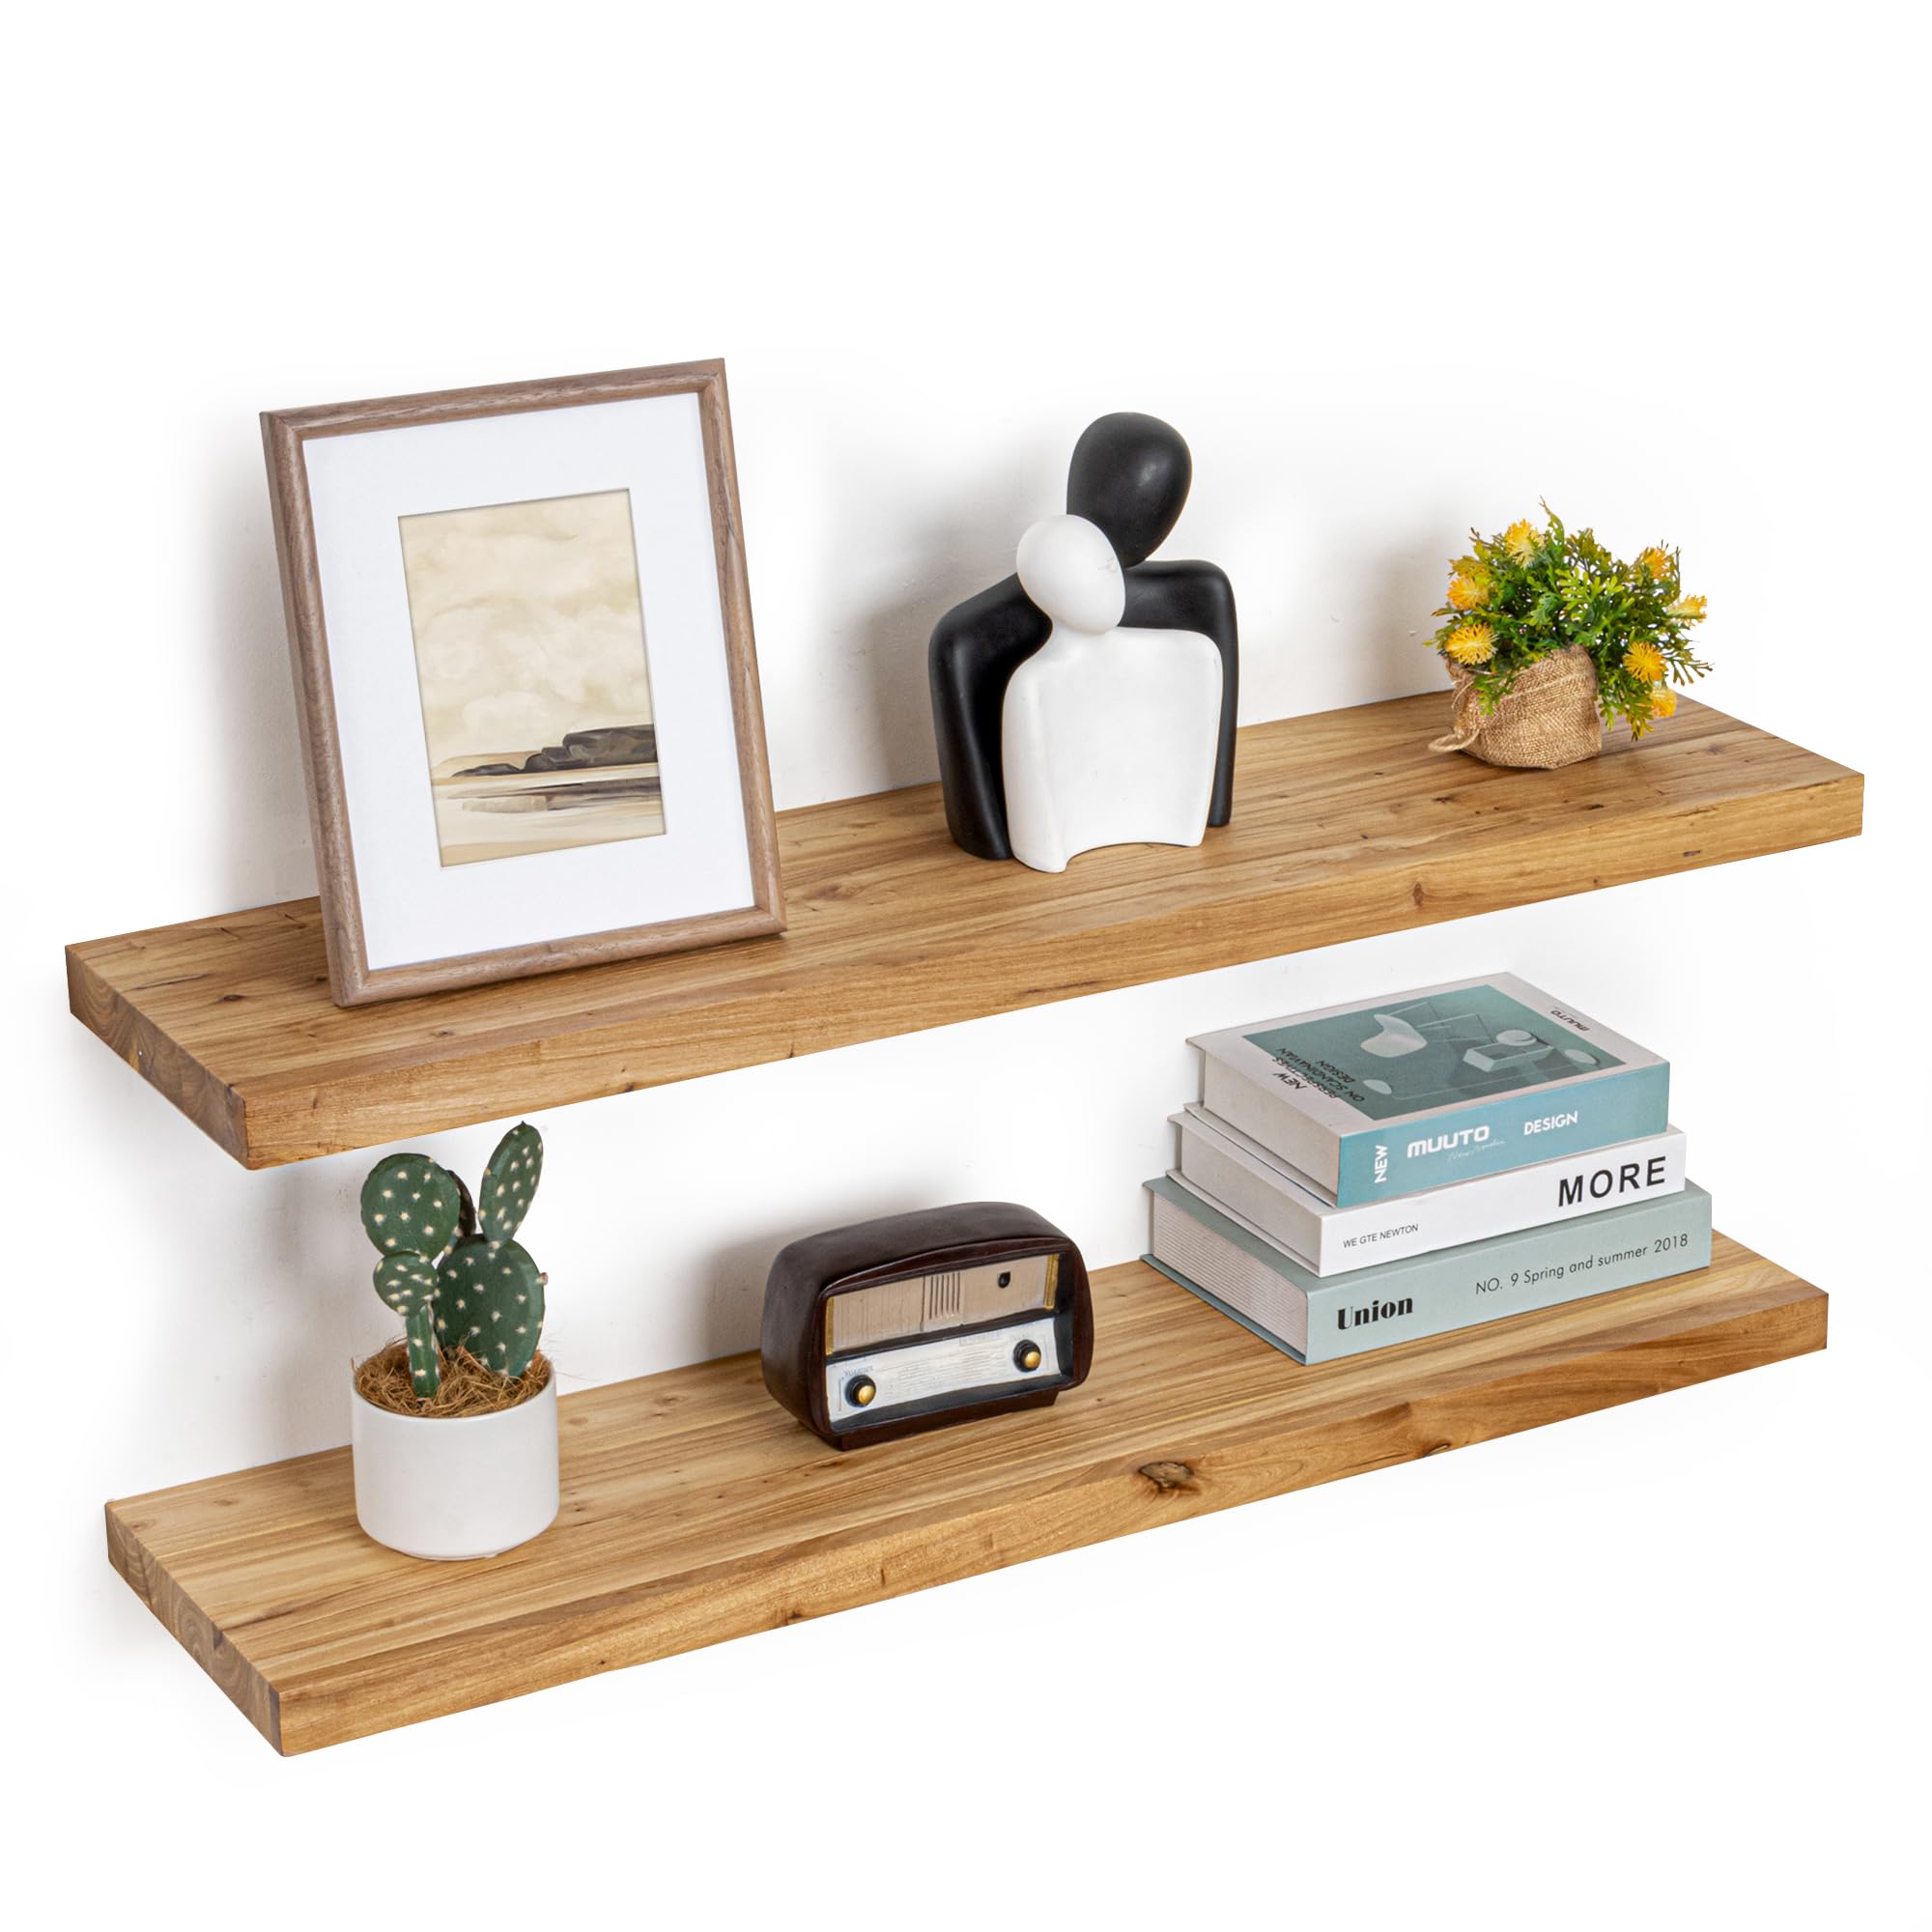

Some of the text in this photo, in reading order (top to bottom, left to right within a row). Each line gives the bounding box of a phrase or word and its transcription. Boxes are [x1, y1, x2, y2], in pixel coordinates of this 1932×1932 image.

[1272, 1072, 1307, 1090] NEW
[1315, 1061, 1355, 1082] DESIGN
[1345, 1091, 1365, 1101] ON
[1523, 1111, 1578, 1135] DESIGN
[1406, 1125, 1490, 1158] MUUTO
[1374, 1145, 1388, 1183] NEW
[1558, 1156, 1666, 1207] MORE
[1343, 1223, 1418, 1248] WE GTE NEWTON
[1476, 1234, 1689, 1295] NO. 9 Spring and summer 2018
[1337, 1297, 1413, 1330] Union
